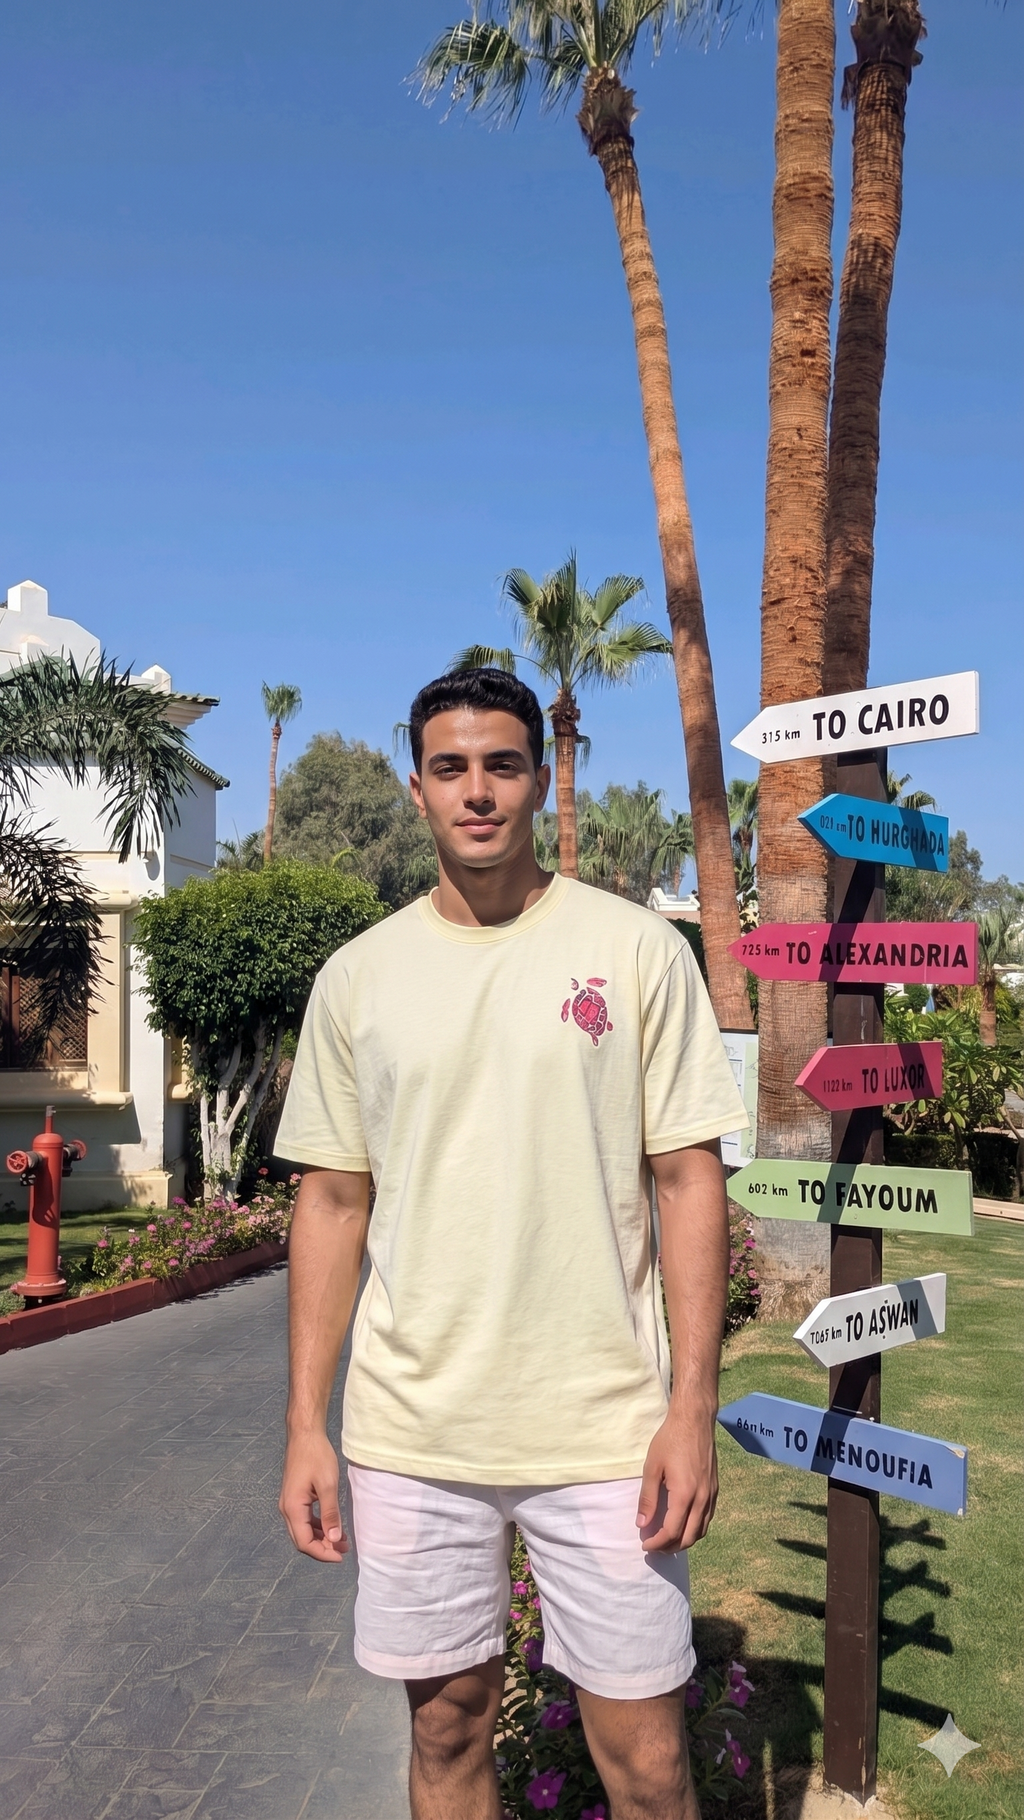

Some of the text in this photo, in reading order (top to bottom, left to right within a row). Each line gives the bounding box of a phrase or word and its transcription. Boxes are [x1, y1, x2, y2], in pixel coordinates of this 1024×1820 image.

[762, 694, 949, 744] 315 km TO CAIRO
[848, 814, 865, 842] TO
[871, 819, 945, 856] HURGHADA
[742, 942, 968, 968] 725 km TO ALEXANDRIA
[842, 1078, 853, 1092] km
[862, 1067, 879, 1094] TO
[884, 1063, 925, 1093] LUXOR
[748, 1179, 938, 1213] 602 km TO FAYOUM
[831, 1326, 842, 1340] km
[845, 1311, 863, 1343] TO
[759, 1422, 774, 1438] km
[784, 1426, 808, 1453] TO
[815, 1436, 933, 1489] MENOUFIA
